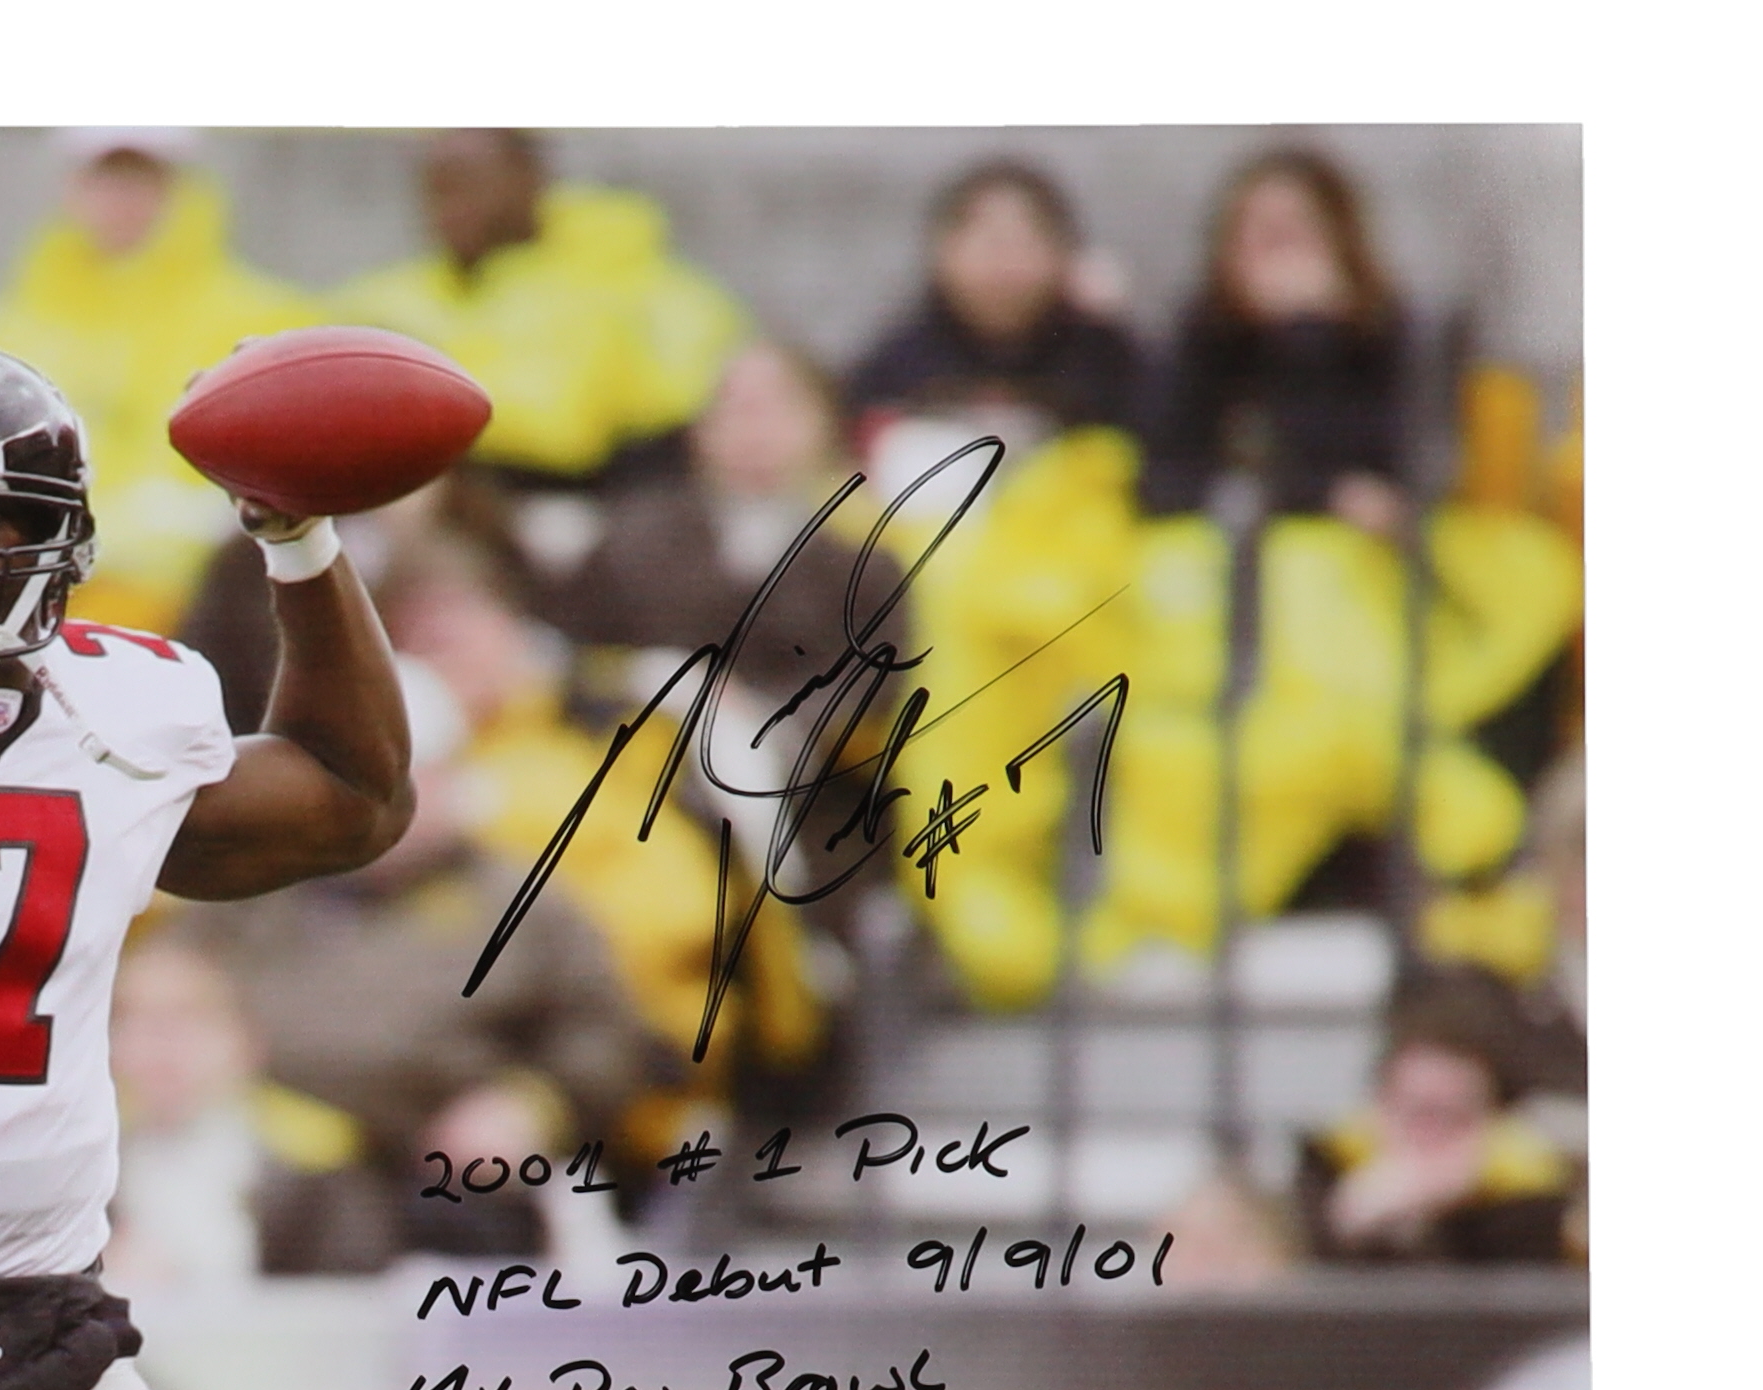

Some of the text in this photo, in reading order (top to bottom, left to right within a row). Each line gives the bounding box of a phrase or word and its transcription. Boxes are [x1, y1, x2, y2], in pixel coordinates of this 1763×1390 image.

[417, 1223, 1174, 1320] NFL Debut 9/9/01
